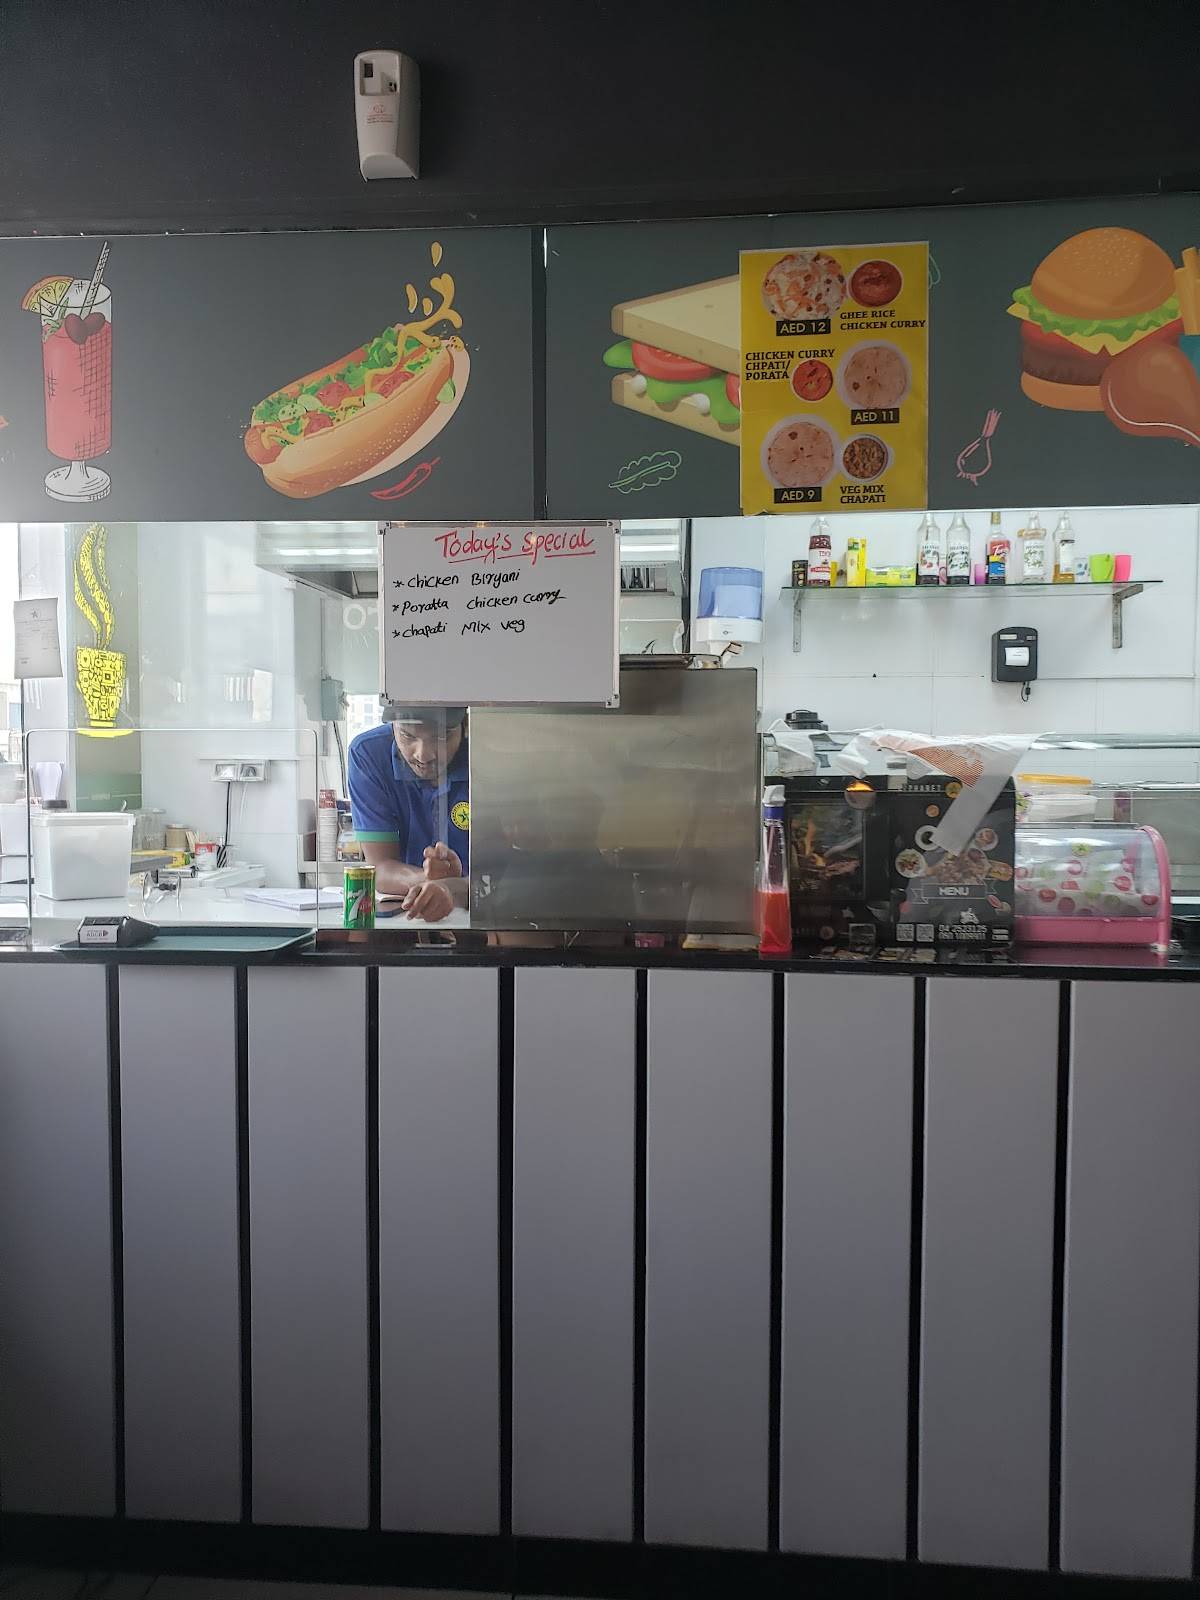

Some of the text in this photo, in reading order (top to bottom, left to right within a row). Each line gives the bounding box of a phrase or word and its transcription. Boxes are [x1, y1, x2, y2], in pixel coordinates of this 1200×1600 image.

[840, 310, 896, 320] GHEE RICE
[780, 321, 827, 334] AED 12
[840, 320, 926, 331] CHICKEN CURRY
[745, 349, 836, 361] CHICKEN CURRY
[745, 360, 791, 371] CHPATI/
[745, 371, 790, 381] PORATA
[854, 411, 894, 422] AED 11
[781, 490, 815, 501] AED 9
[840, 485, 885, 495] VEG MIX
[840, 494, 886, 504] CHAPATI
[435, 530, 512, 564] Today's
[938, 887, 970, 897] MENU
